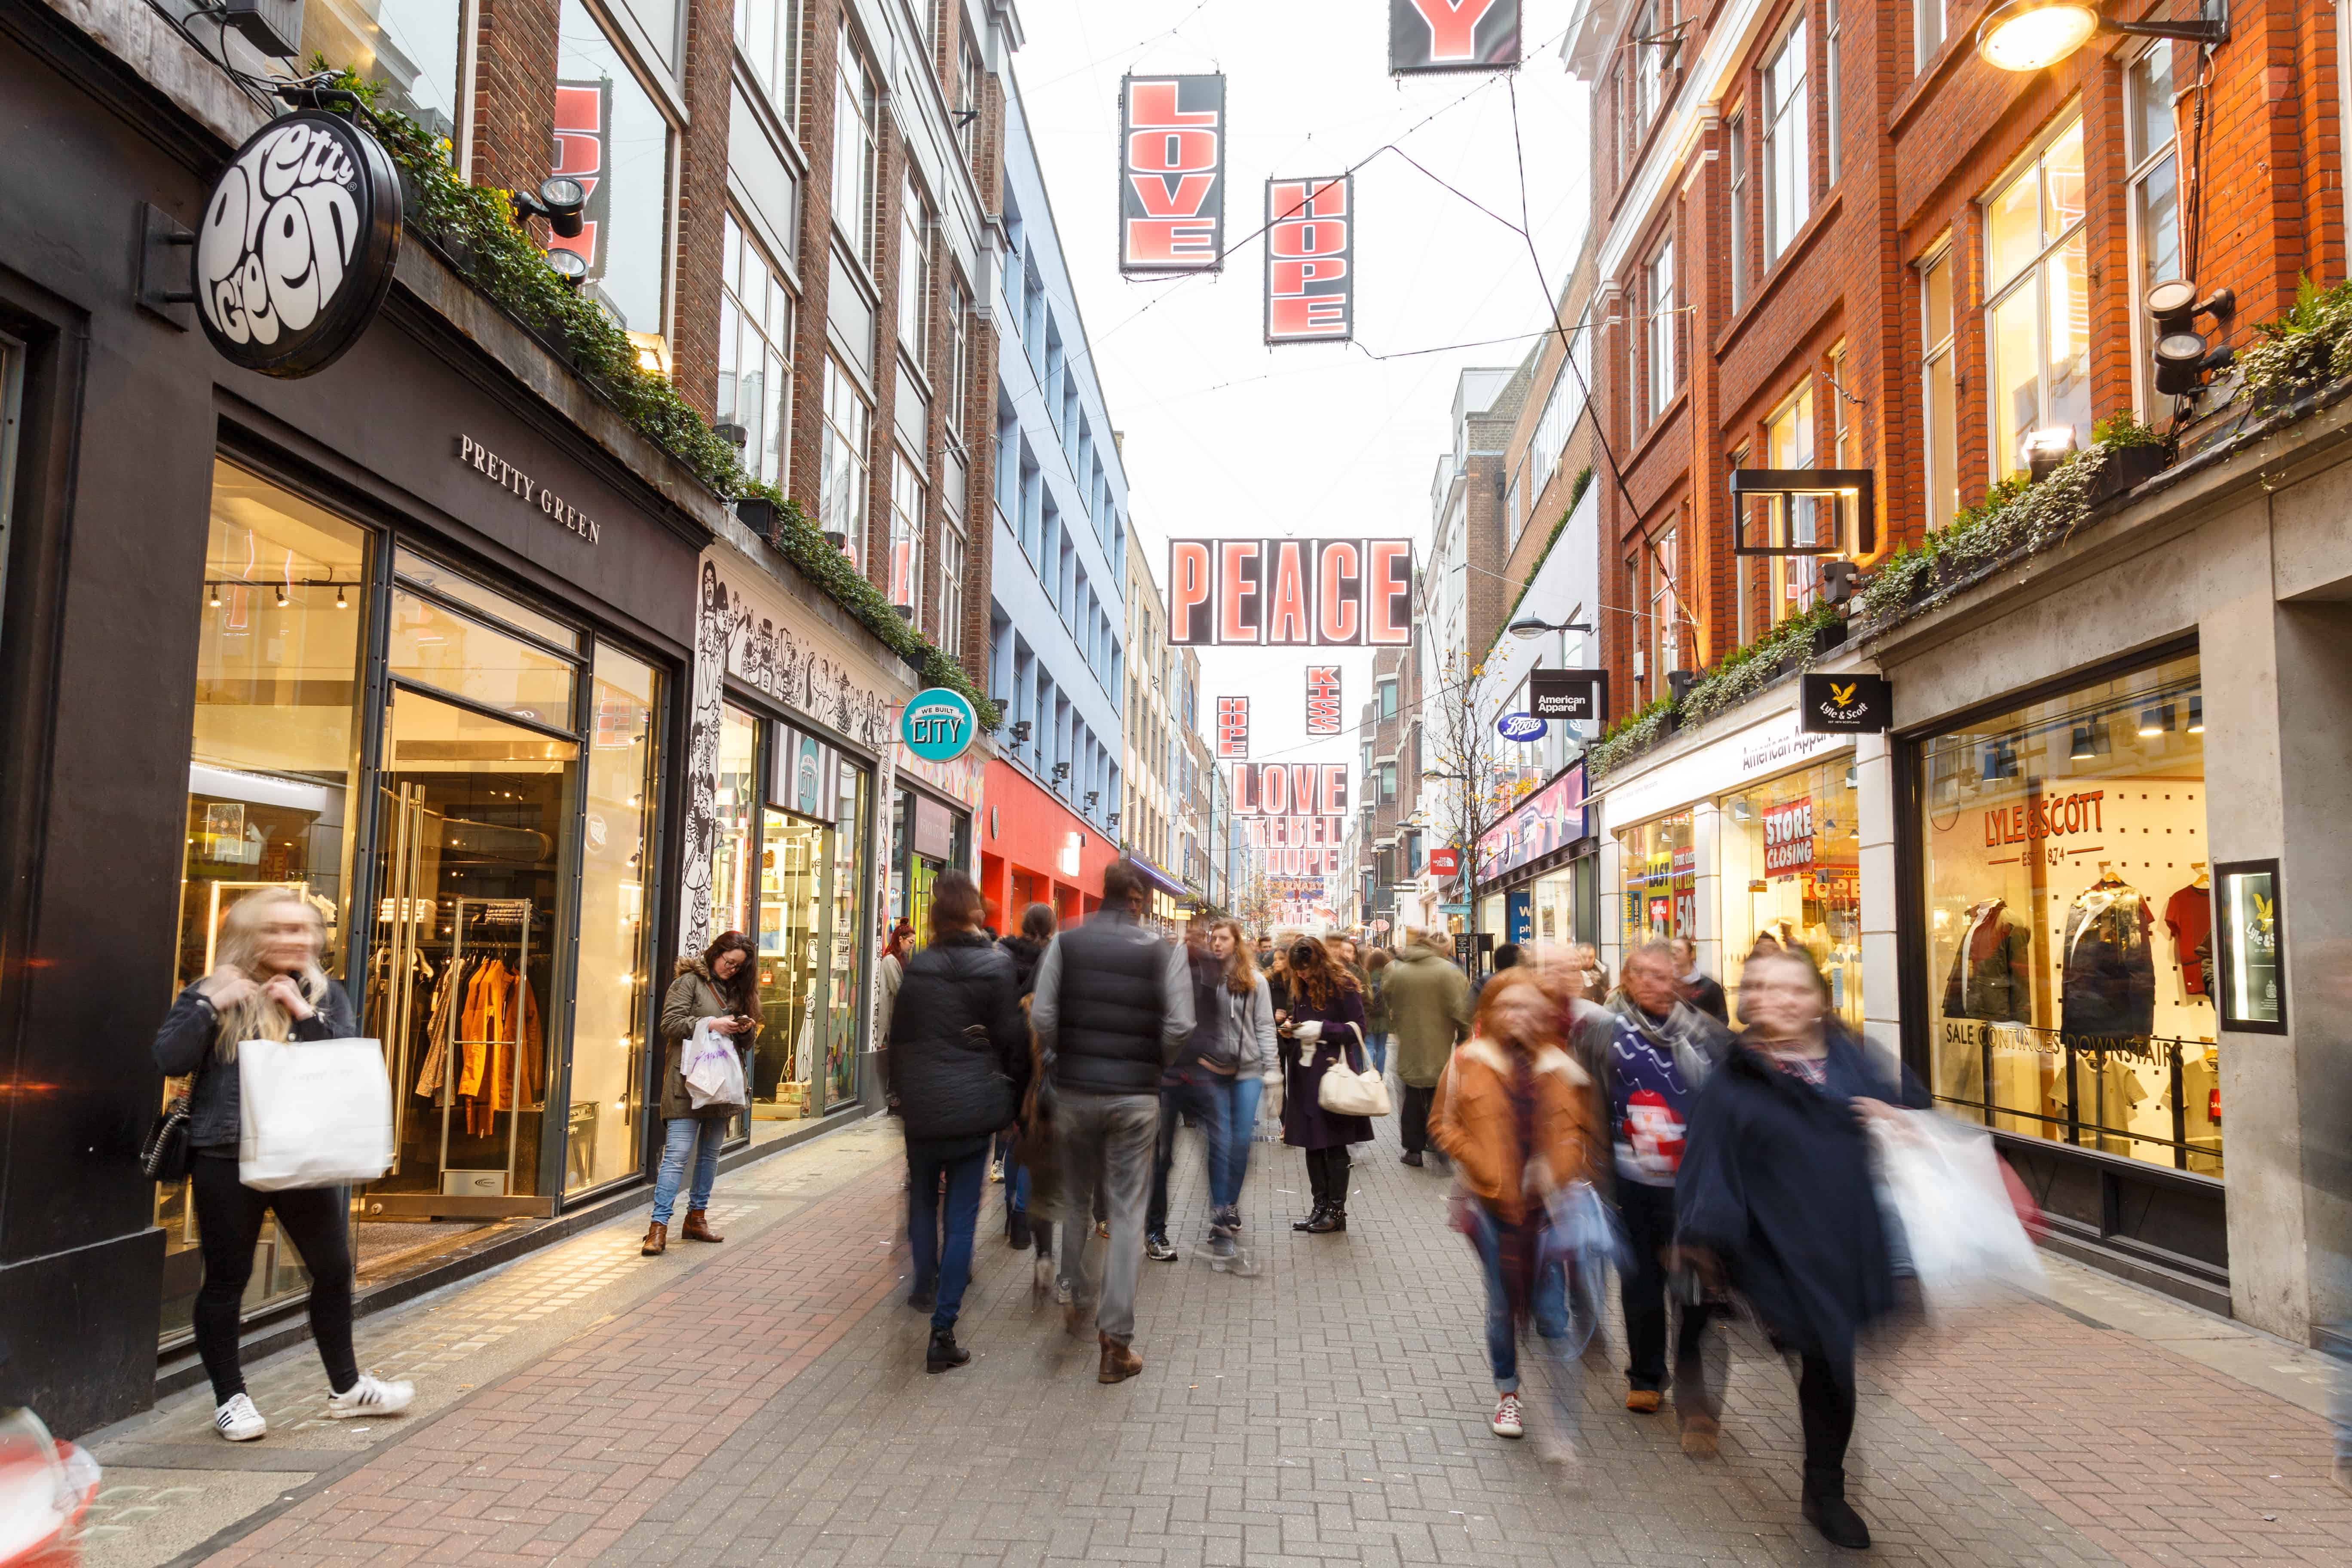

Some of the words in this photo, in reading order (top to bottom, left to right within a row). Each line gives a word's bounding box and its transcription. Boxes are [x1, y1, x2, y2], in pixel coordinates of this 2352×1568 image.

[1127, 81, 1218, 264] LOVE
[1270, 179, 1347, 337] HOPE
[460, 434, 535, 502] PRETTY
[541, 489, 600, 546] GREEN
[1172, 541, 1409, 643] PEACE
[1308, 667, 1340, 733] KISS
[1538, 695, 1585, 704] American
[1538, 703, 1577, 713] Apparel
[1820, 701, 1838, 718] Lyle
[1839, 711, 1845, 720] &
[1847, 702, 1868, 720] Scott
[913, 719, 962, 744] CITY
[1219, 698, 1247, 757] HOPE
[1503, 717, 1541, 735] Boots
[1232, 764, 1346, 815] LOVE
[1250, 816, 1342, 849] REBEL
[1766, 804, 1812, 846] STORE
[1985, 805, 2025, 847] LYLE
[2027, 808, 2040, 841] &
[2040, 790, 2104, 839] SCOTT
[1649, 861, 1669, 888] LAST
[1767, 840, 1813, 870] CLOSING
[2245, 922, 2263, 945] Lyle
[1946, 1023, 1974, 1045] SALE
[1978, 1026, 2061, 1054] CONTINUES
[2066, 1033, 2184, 1068] DOWNSTAIRS
